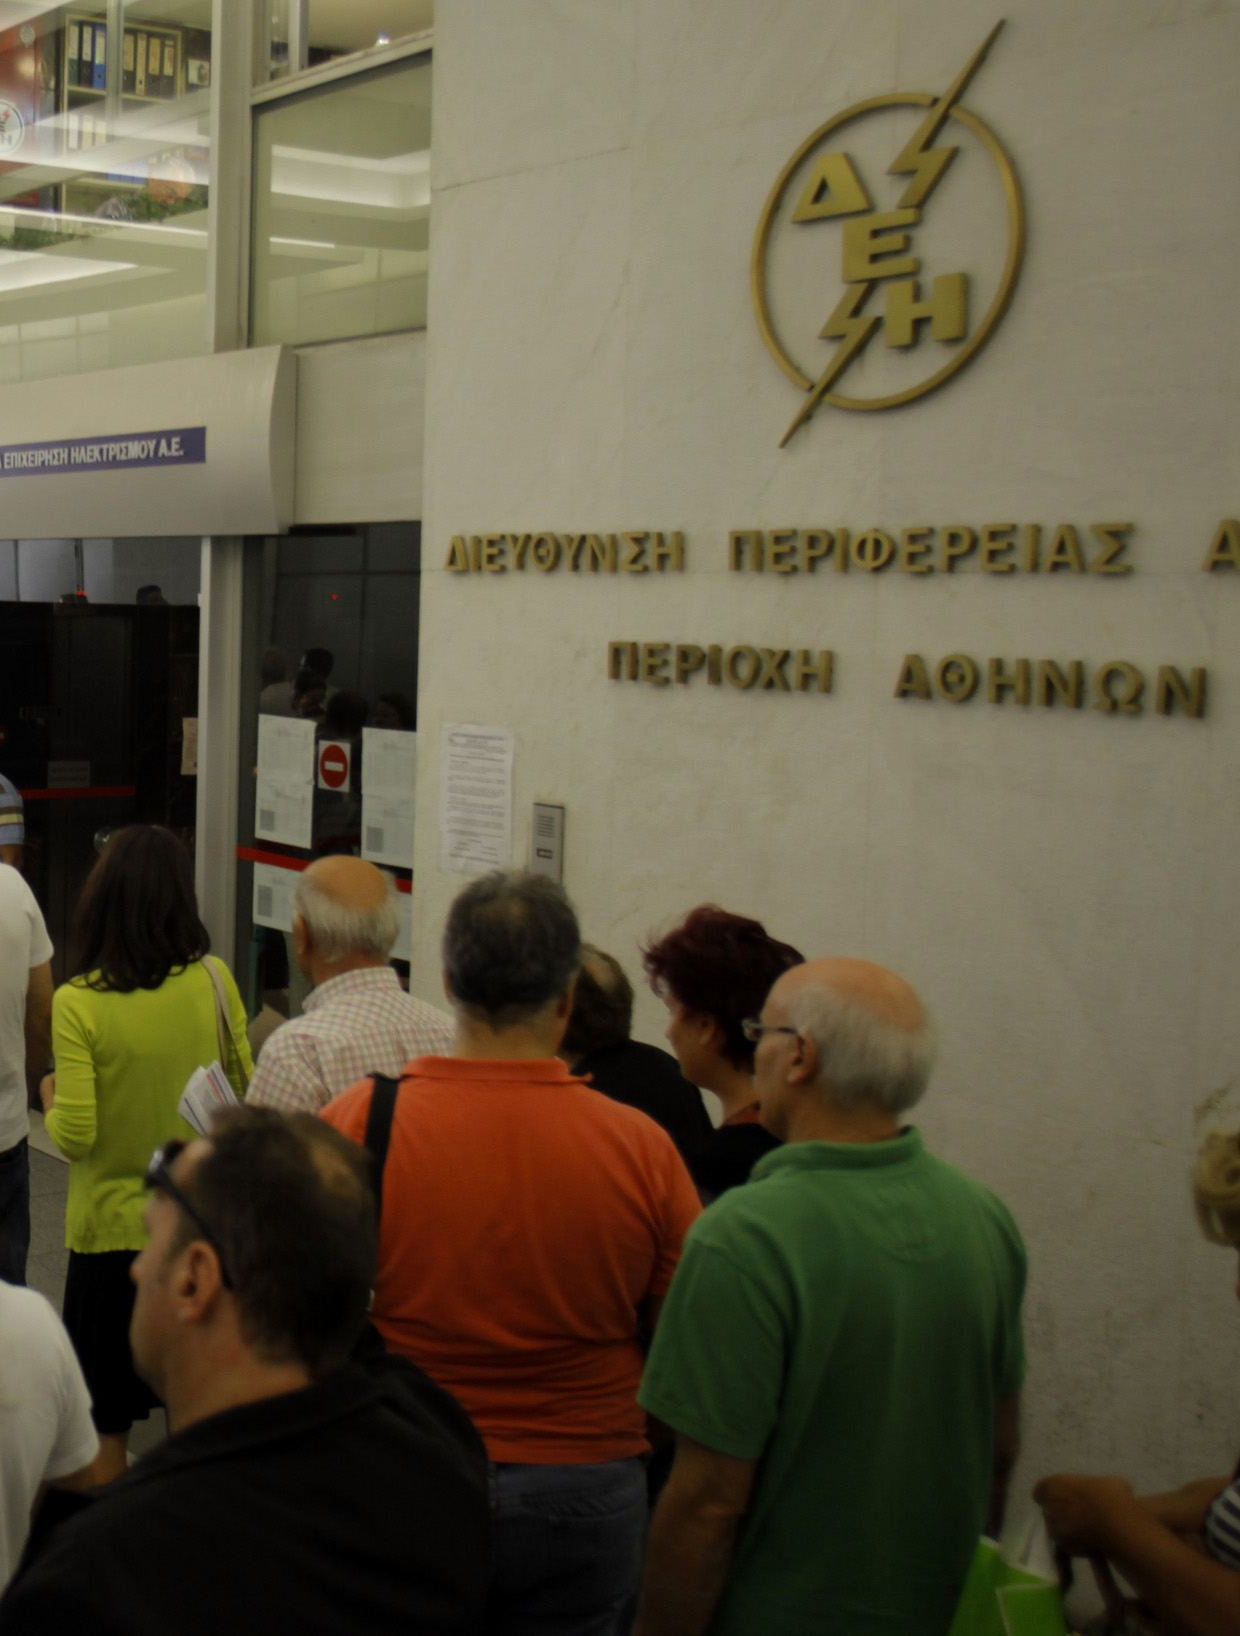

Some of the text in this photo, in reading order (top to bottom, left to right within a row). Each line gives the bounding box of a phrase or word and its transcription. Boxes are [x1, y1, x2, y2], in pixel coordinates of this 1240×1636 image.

[790, 152, 969, 348] ΔΕΗ
[3, 447, 69, 469] ΕΠΙΧΕΙΡΗΣΗ
[70, 438, 158, 464] ΗΛΕΚΤΡΙΣΜΟΥ
[158, 436, 185, 457] Α.Ε.
[443, 530, 685, 574] ΔΙΕΥΘΥΝΣΗ
[727, 522, 1135, 574] ΠΕΡΙΦΕΡΕΙΑΣ
[607, 640, 1207, 718] ΠΕΡΙΟΧΗ ΑΘΗΝΩΝ
